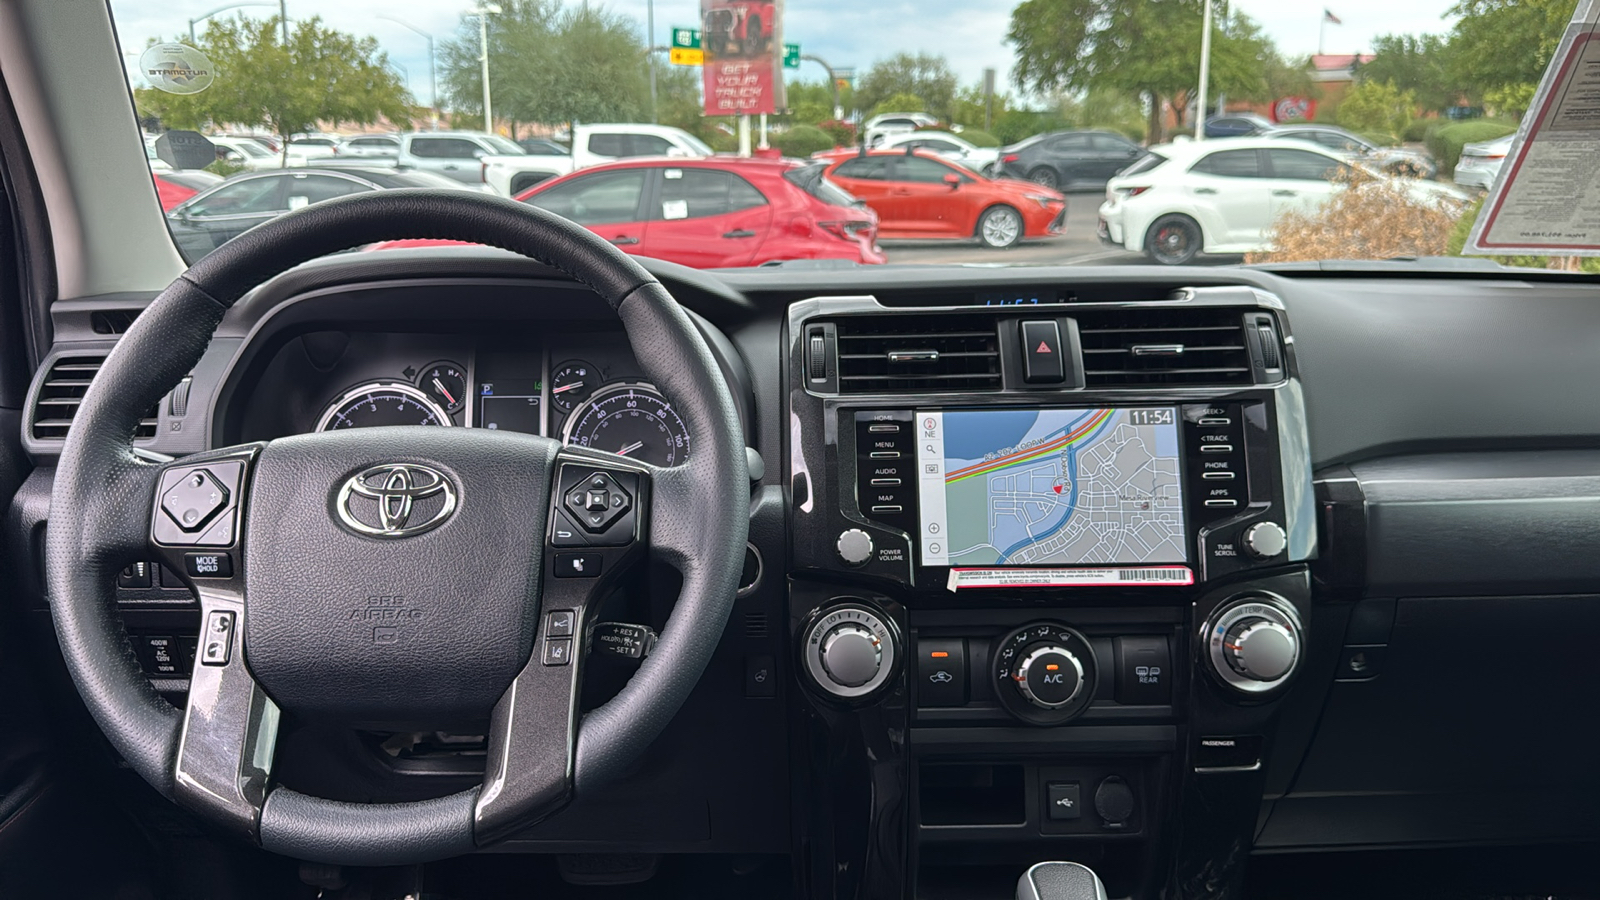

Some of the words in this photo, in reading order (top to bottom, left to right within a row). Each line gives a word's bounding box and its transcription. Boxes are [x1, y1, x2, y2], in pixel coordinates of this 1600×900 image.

[722, 63, 751, 75] GET
[717, 74, 758, 86] YOUR
[715, 86, 763, 98] TRUCK
[718, 98, 758, 109] BUILT
[370, 404, 377, 412] 3
[596, 410, 607, 419] 40
[656, 409, 667, 419] 80
[1132, 411, 1172, 424] 11:54
[345, 419, 353, 427] 2
[674, 434, 684, 448] 100
[196, 556, 218, 565] MODE
[350, 609, 423, 620] AIRBAG
[826, 616, 837, 625] LO
[620, 628, 633, 636] RES
[814, 624, 825, 638] OFF
[878, 629, 886, 638] HI
[1044, 674, 1063, 683] A/C
